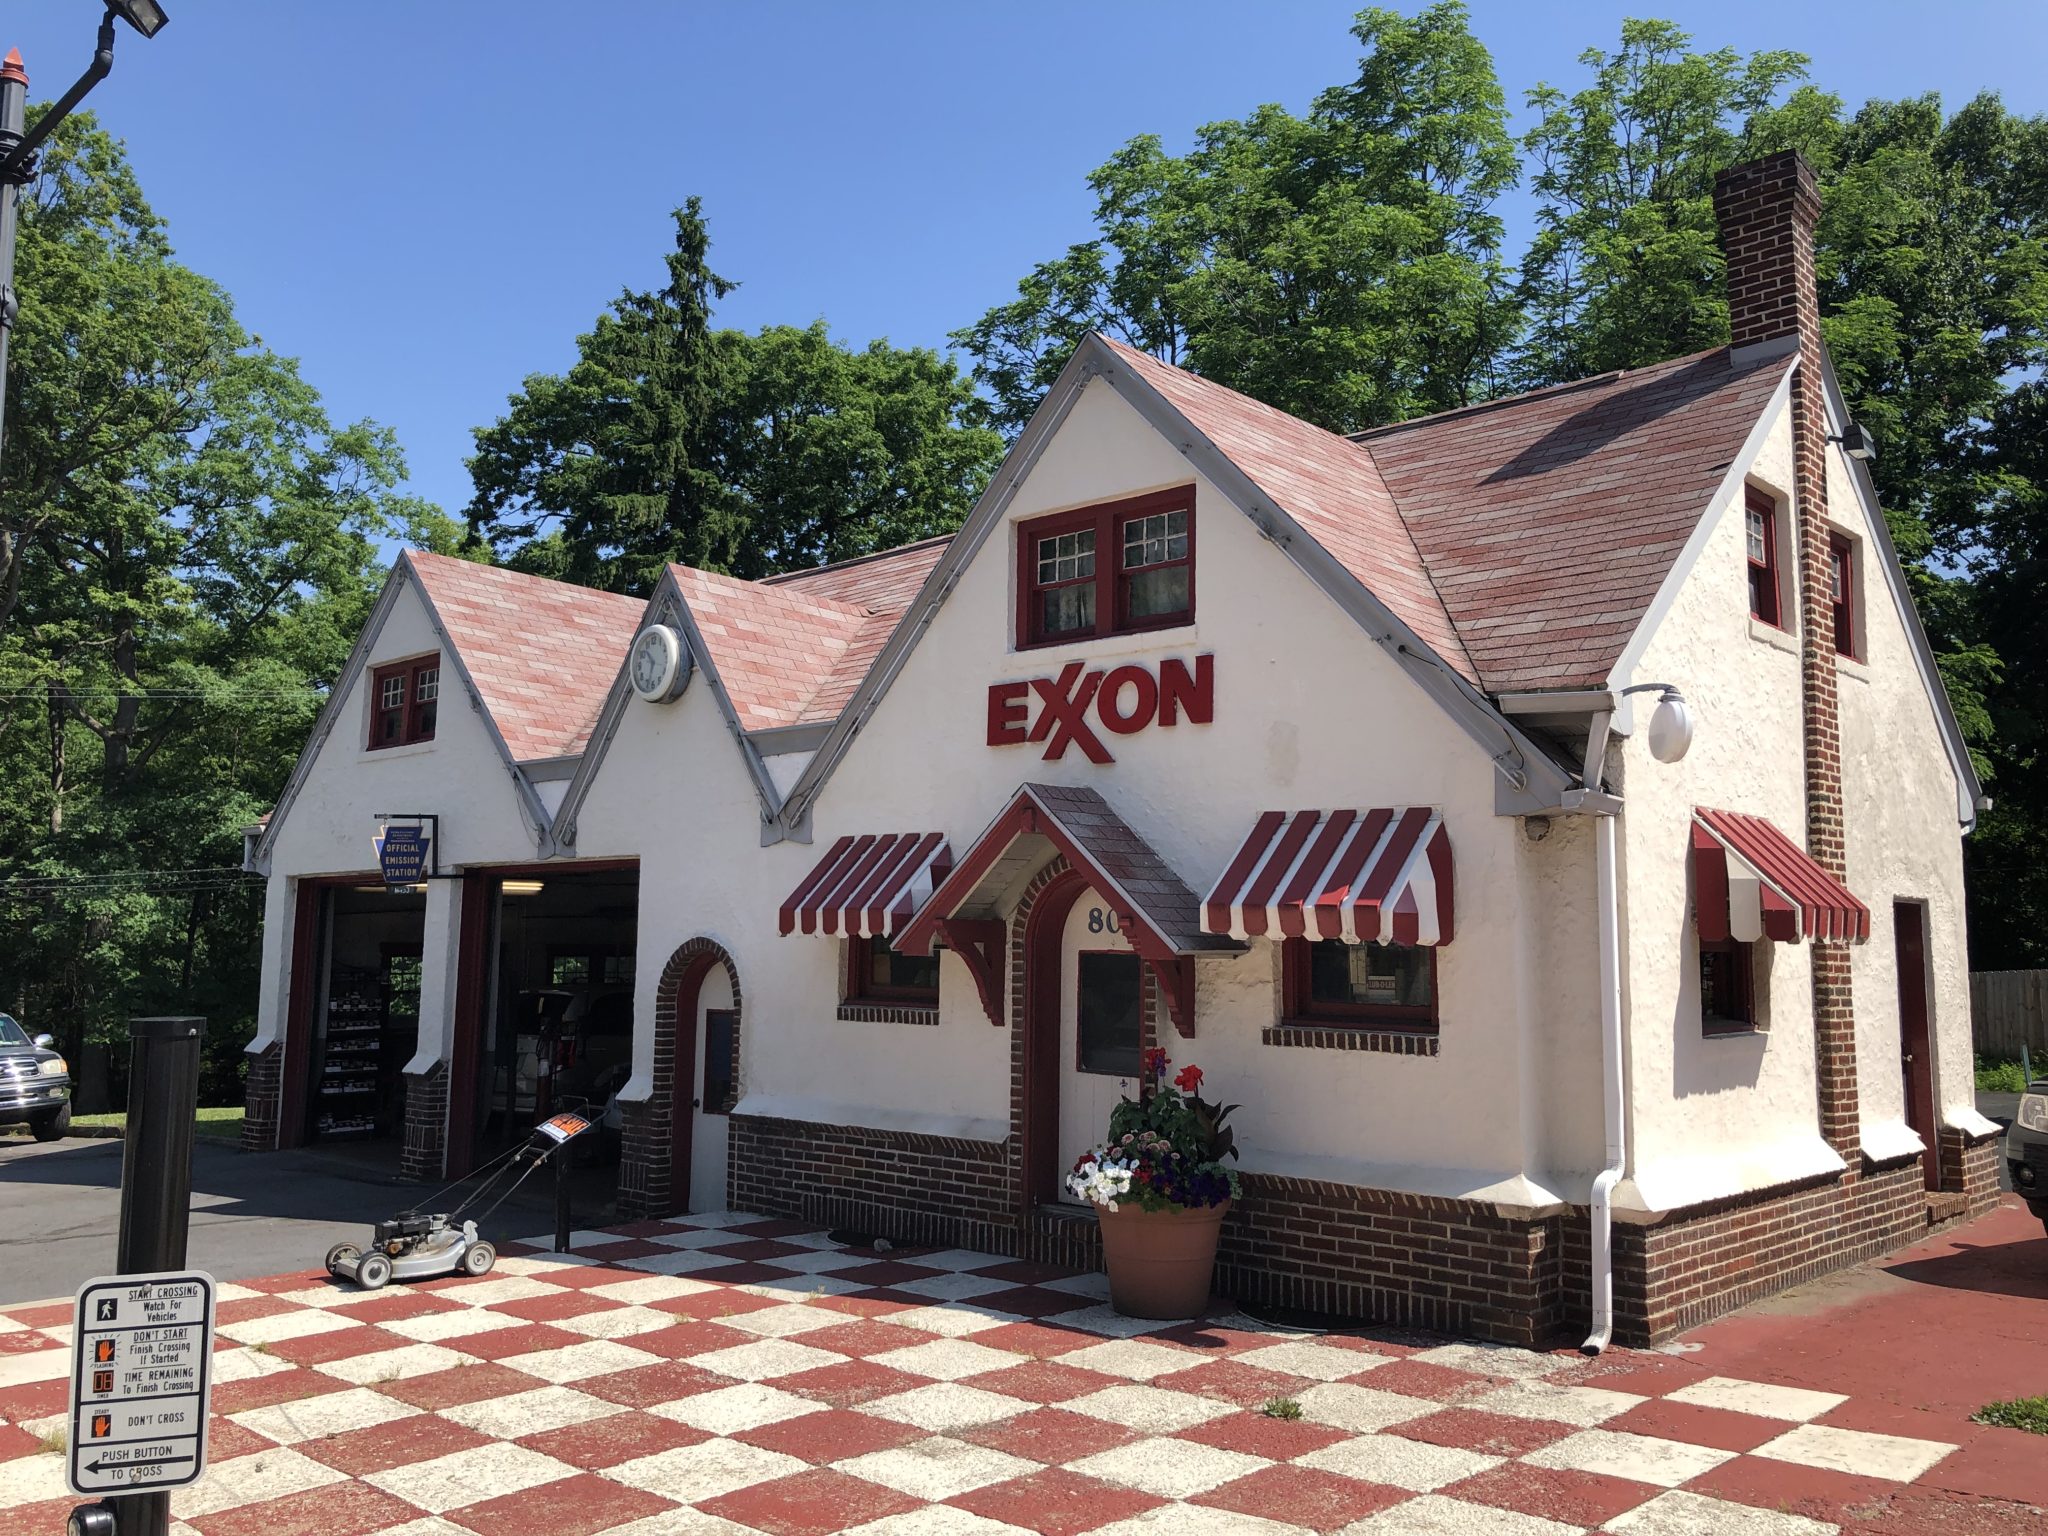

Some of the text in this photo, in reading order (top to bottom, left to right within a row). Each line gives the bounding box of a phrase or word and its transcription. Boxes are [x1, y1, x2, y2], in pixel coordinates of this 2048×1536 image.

[986, 654, 1214, 764] EXXON
[386, 843, 419, 852] OFFICIAL
[385, 856, 419, 865] EMISSION
[386, 868, 417, 877] STATION
[128, 1286, 198, 1300] START CROSSING
[143, 1300, 182, 1312] Watch For
[147, 1311, 177, 1322] Vehicles
[133, 1328, 188, 1341] DON'T START
[129, 1341, 191, 1355] Finish Crossing
[140, 1352, 179, 1365] If Started
[124, 1368, 194, 1383] TIME REMAINING
[123, 1380, 194, 1394] To Finish Crossing
[128, 1412, 185, 1427] DON'T CROSS
[102, 1446, 173, 1461] PUSH BUTTON
[111, 1465, 163, 1480] TO CROSS
